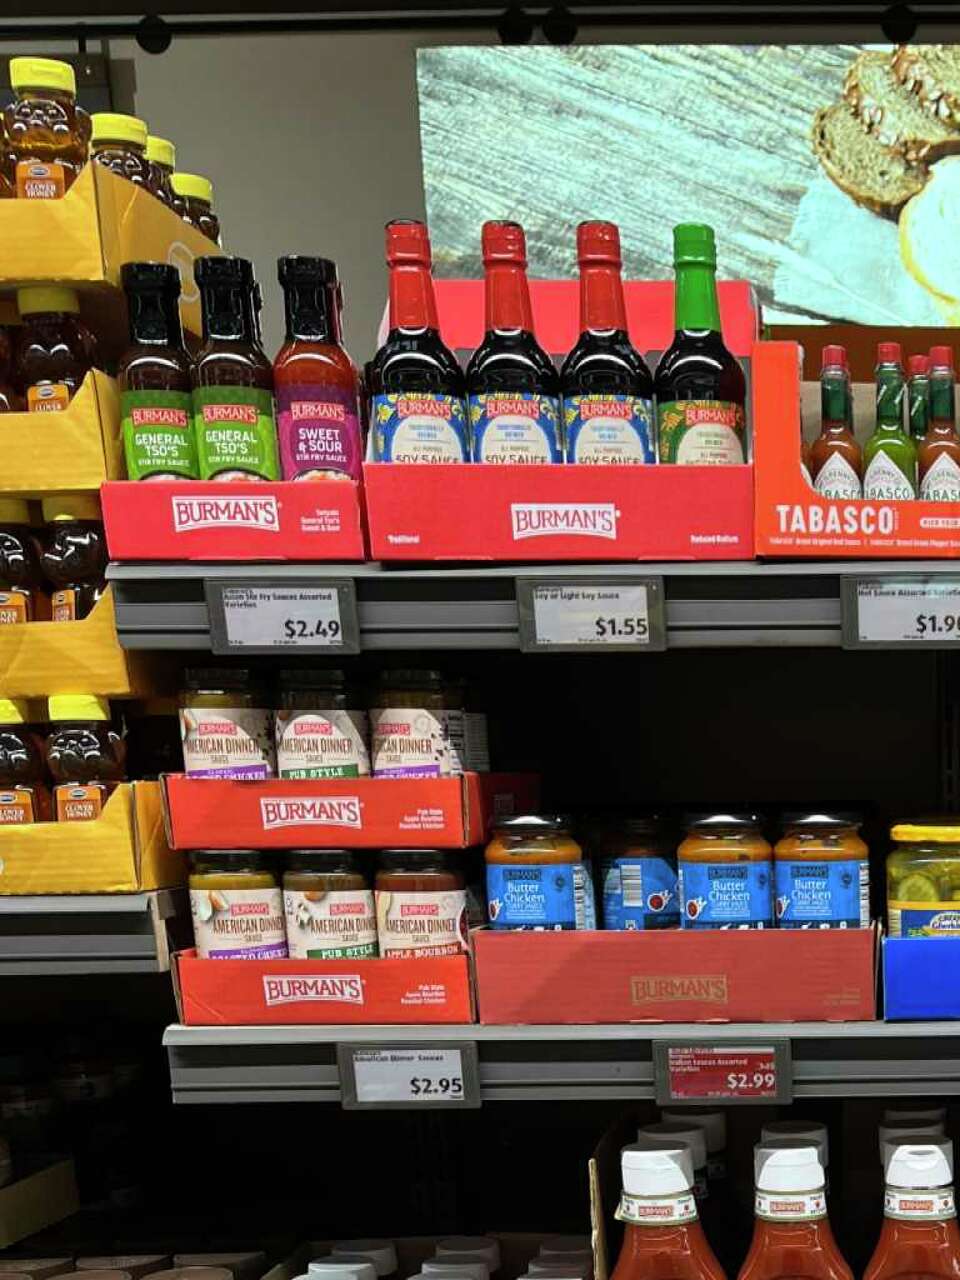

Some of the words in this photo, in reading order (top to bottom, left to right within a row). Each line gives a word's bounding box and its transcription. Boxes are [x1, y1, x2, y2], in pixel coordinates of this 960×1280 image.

[135, 434, 187, 445] GENERAL
[206, 431, 257, 442] GENERAL
[299, 429, 339, 441] SWEET
[299, 441, 308, 452] &
[310, 441, 342, 452] SOUR
[176, 502, 275, 525] BURMAN'S
[776, 505, 894, 534] TABASCO
[515, 509, 612, 533] BURMAN'S
[285, 620, 339, 638] $2.49
[595, 618, 647, 636] $1.55
[265, 801, 358, 823] BURMAN'S
[508, 881, 539, 893] Butter
[713, 880, 744, 891] Butter
[795, 879, 826, 890] Butter
[504, 892, 545, 903] Chicken
[709, 890, 750, 901] Chicken
[791, 889, 831, 900] Chicken
[213, 919, 253, 933] AMERICAN
[311, 919, 352, 933] AMERICAN
[386, 920, 425, 933] AMERICAN
[428, 919, 457, 932] DINNER
[267, 980, 360, 1000] BURMAN'S
[634, 980, 725, 1001] BURMAN'S
[411, 1078, 462, 1095] $2.95
[728, 1074, 775, 1089] $2.99
